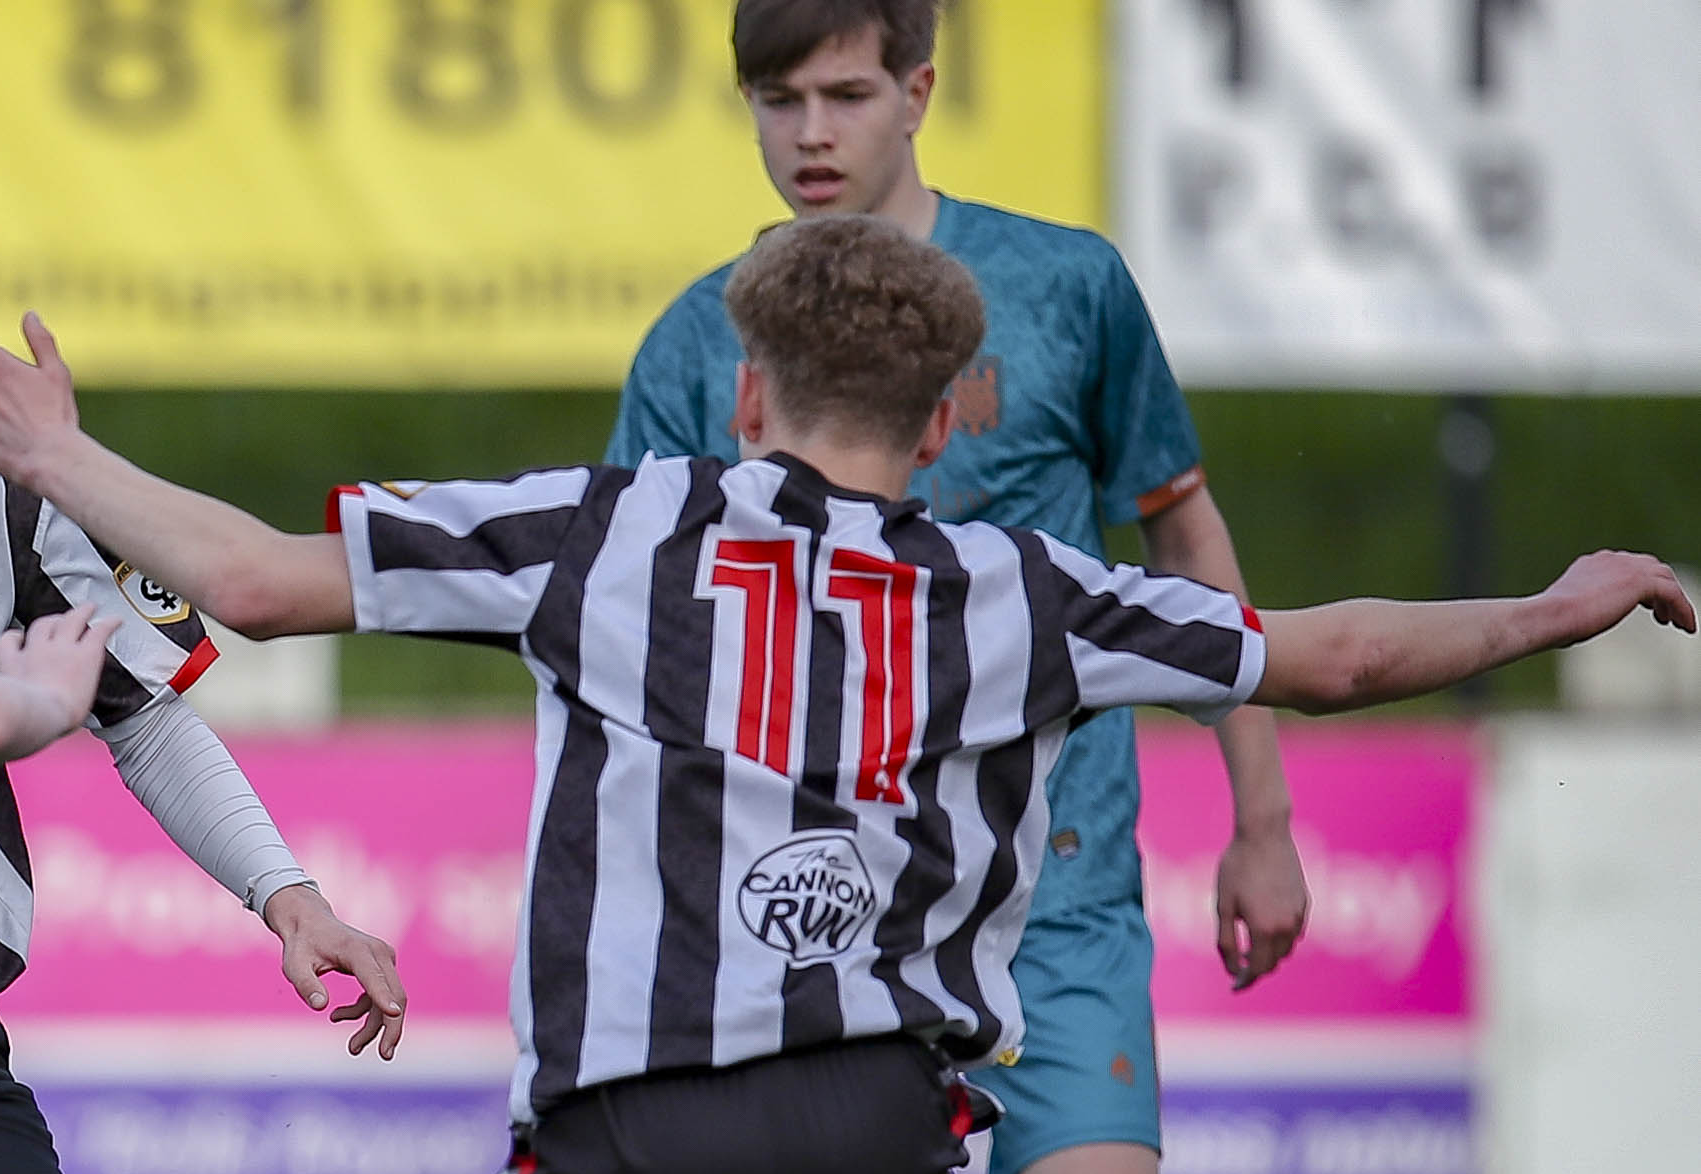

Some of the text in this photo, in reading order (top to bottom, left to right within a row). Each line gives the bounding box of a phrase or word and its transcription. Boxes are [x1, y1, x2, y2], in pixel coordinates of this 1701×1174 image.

[694, 522, 930, 818] 11
[745, 868, 875, 915] CANNON
[758, 896, 857, 958] RUN
